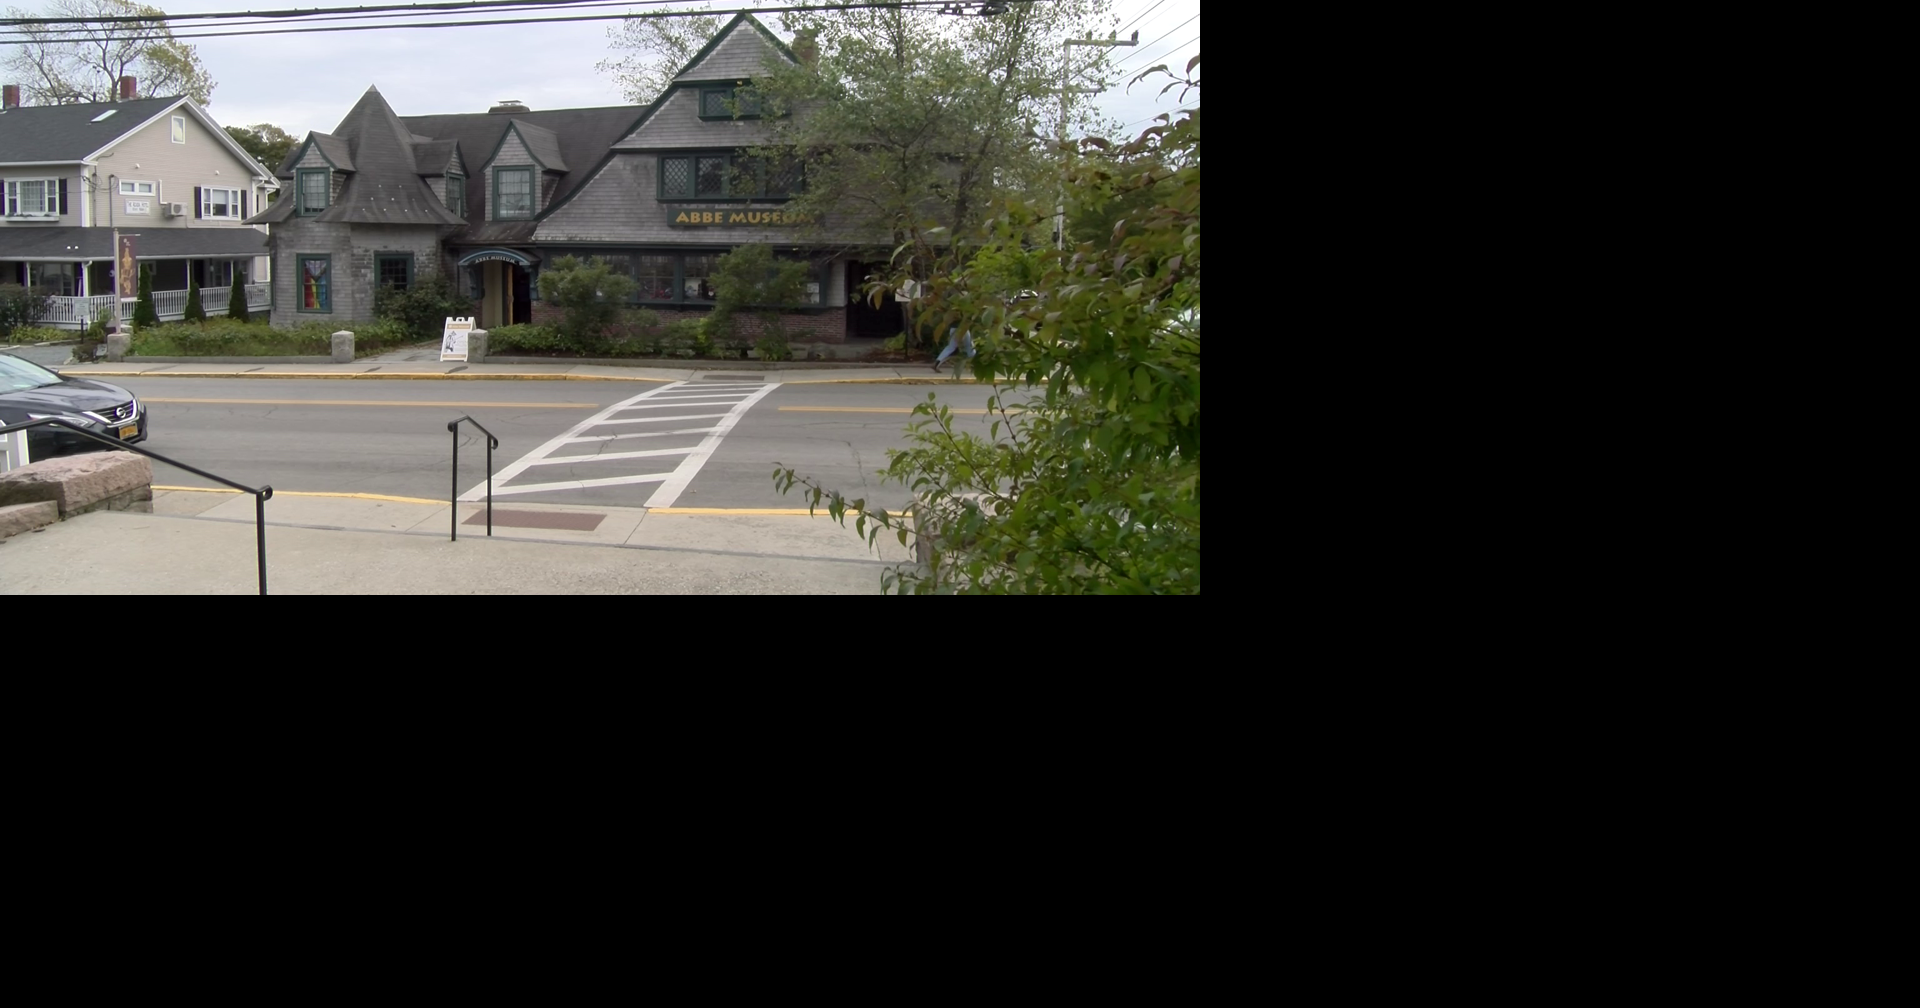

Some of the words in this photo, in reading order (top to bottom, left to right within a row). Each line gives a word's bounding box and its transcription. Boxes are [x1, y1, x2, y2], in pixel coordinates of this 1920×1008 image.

[675, 211, 723, 224] ABBE
[474, 256, 489, 264] ABBE
[490, 255, 517, 264] MUSEUM
